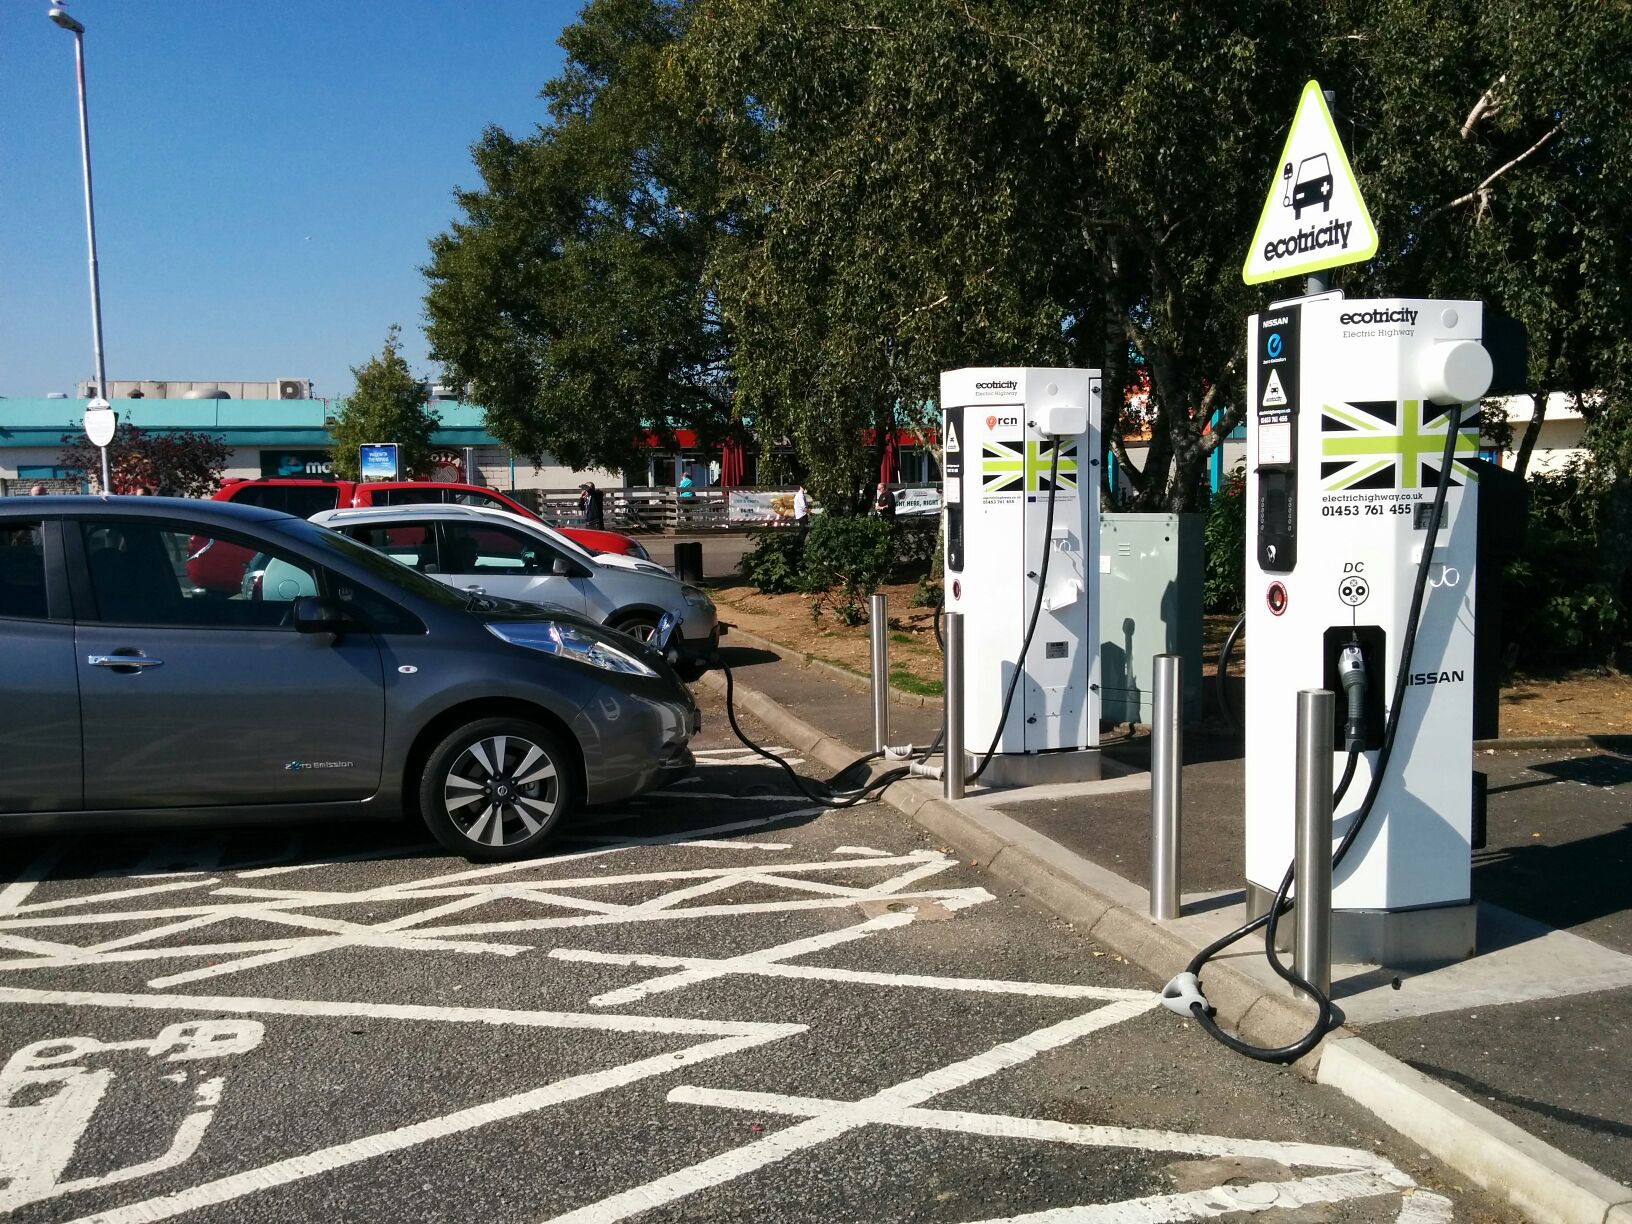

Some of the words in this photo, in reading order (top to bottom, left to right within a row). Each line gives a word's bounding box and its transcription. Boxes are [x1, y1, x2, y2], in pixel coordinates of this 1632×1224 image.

[1264, 219, 1352, 261] ecotricity
[1340, 307, 1418, 325] ecotricity
[1263, 317, 1288, 328] NISSAN
[1343, 330, 1376, 338] Electric
[1378, 329, 1415, 337] Highway
[976, 381, 1018, 390] ecotricity
[998, 417, 1018, 425] rcn
[306, 461, 334, 474] mo
[1322, 493, 1423, 503] electrichighway.co.uk
[1322, 506, 1359, 516] 01453
[1365, 505, 1384, 515] 761
[1389, 504, 1412, 514] 455
[1343, 562, 1364, 573] DC
[1406, 670, 1464, 686] ISSAN
